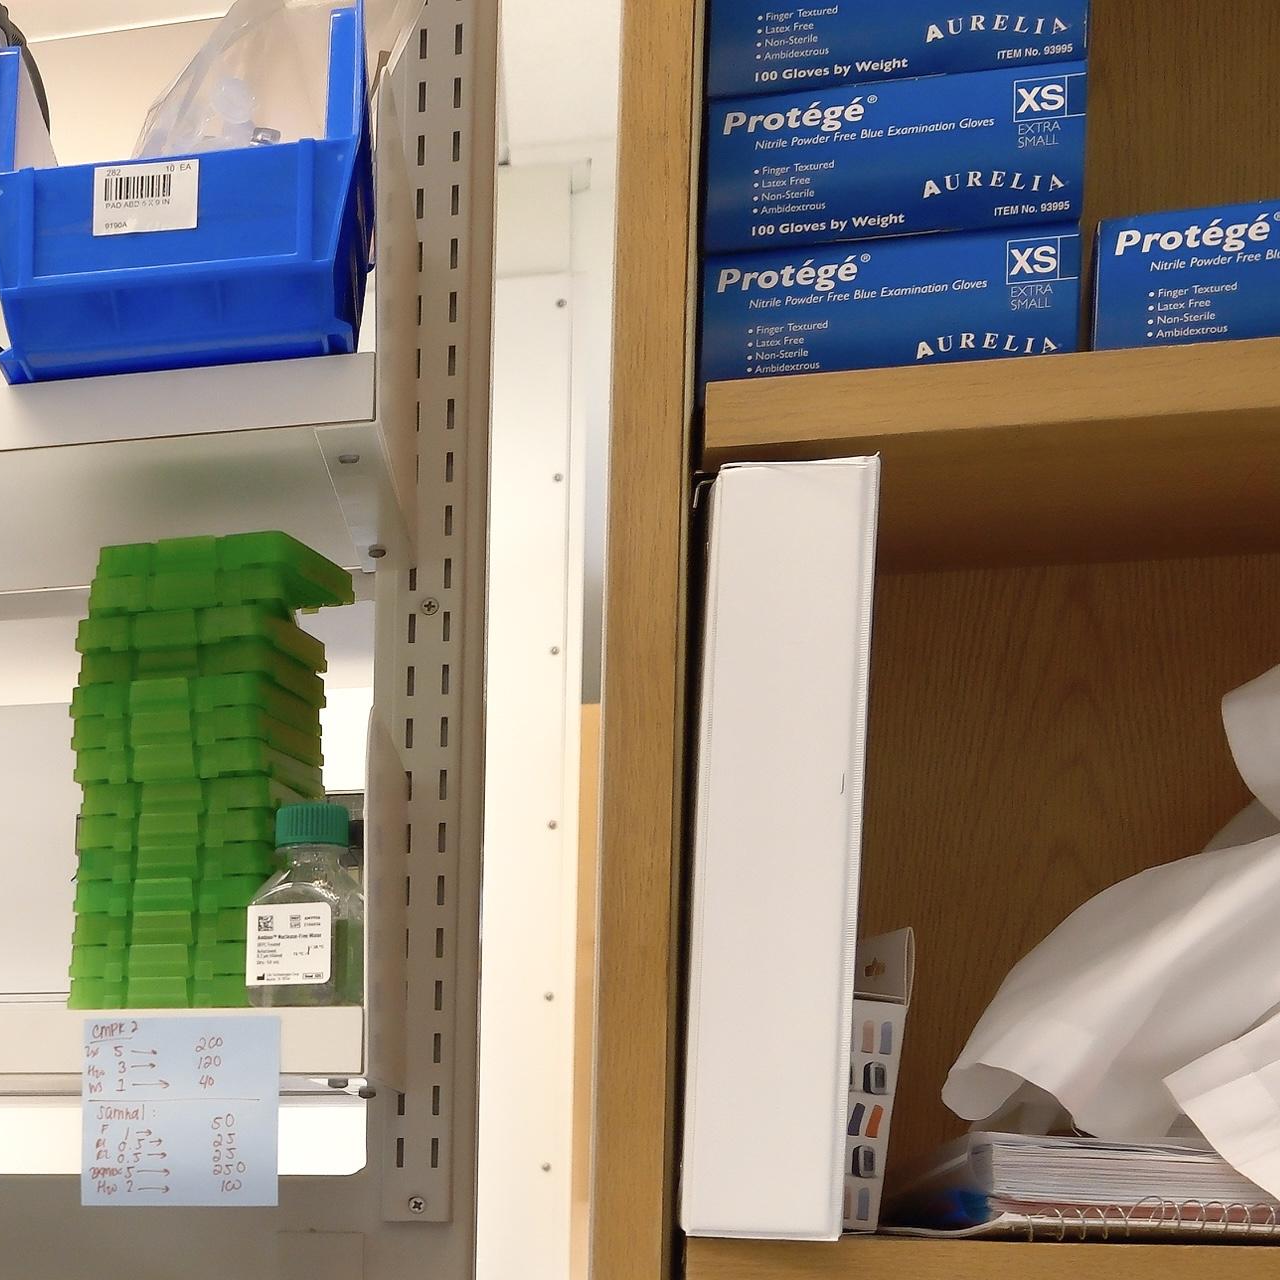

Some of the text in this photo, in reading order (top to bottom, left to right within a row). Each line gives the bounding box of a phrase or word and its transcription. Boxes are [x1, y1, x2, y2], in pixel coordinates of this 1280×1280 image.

[765, 5, 838, 22] Finger Textured
[765, 21, 814, 35] Latex Free
[926, 14, 1068, 43] AURELIA
[764, 33, 818, 48] Non-Sterile
[763, 46, 829, 61] Ambidextrous
[997, 43, 1073, 60] ITEM No. 93995
[754, 57, 908, 82] 100 Gloves by Weight
[1016, 84, 1065, 113] XS
[755, 116, 994, 150] Nitrile Powder Free Blue Examination Gloves
[1018, 121, 1061, 136] EXTRA
[1018, 134, 1058, 148] SMALL
[922, 171, 1066, 199] AURELIA
[1150, 251, 1261, 272] Nitrile Powder Free
[1158, 282, 1237, 298] Finger Textured
[1157, 298, 1211, 311] Latex Free
[1157, 311, 1216, 325] Non-Sterile
[1156, 324, 1228, 338] Ambidextrous
[198, 1056, 222, 1069] 120
[199, 1076, 215, 1089] 40
[212, 1113, 235, 1129] 50
[213, 1133, 235, 1146] 25
[213, 1162, 246, 1176] 250
